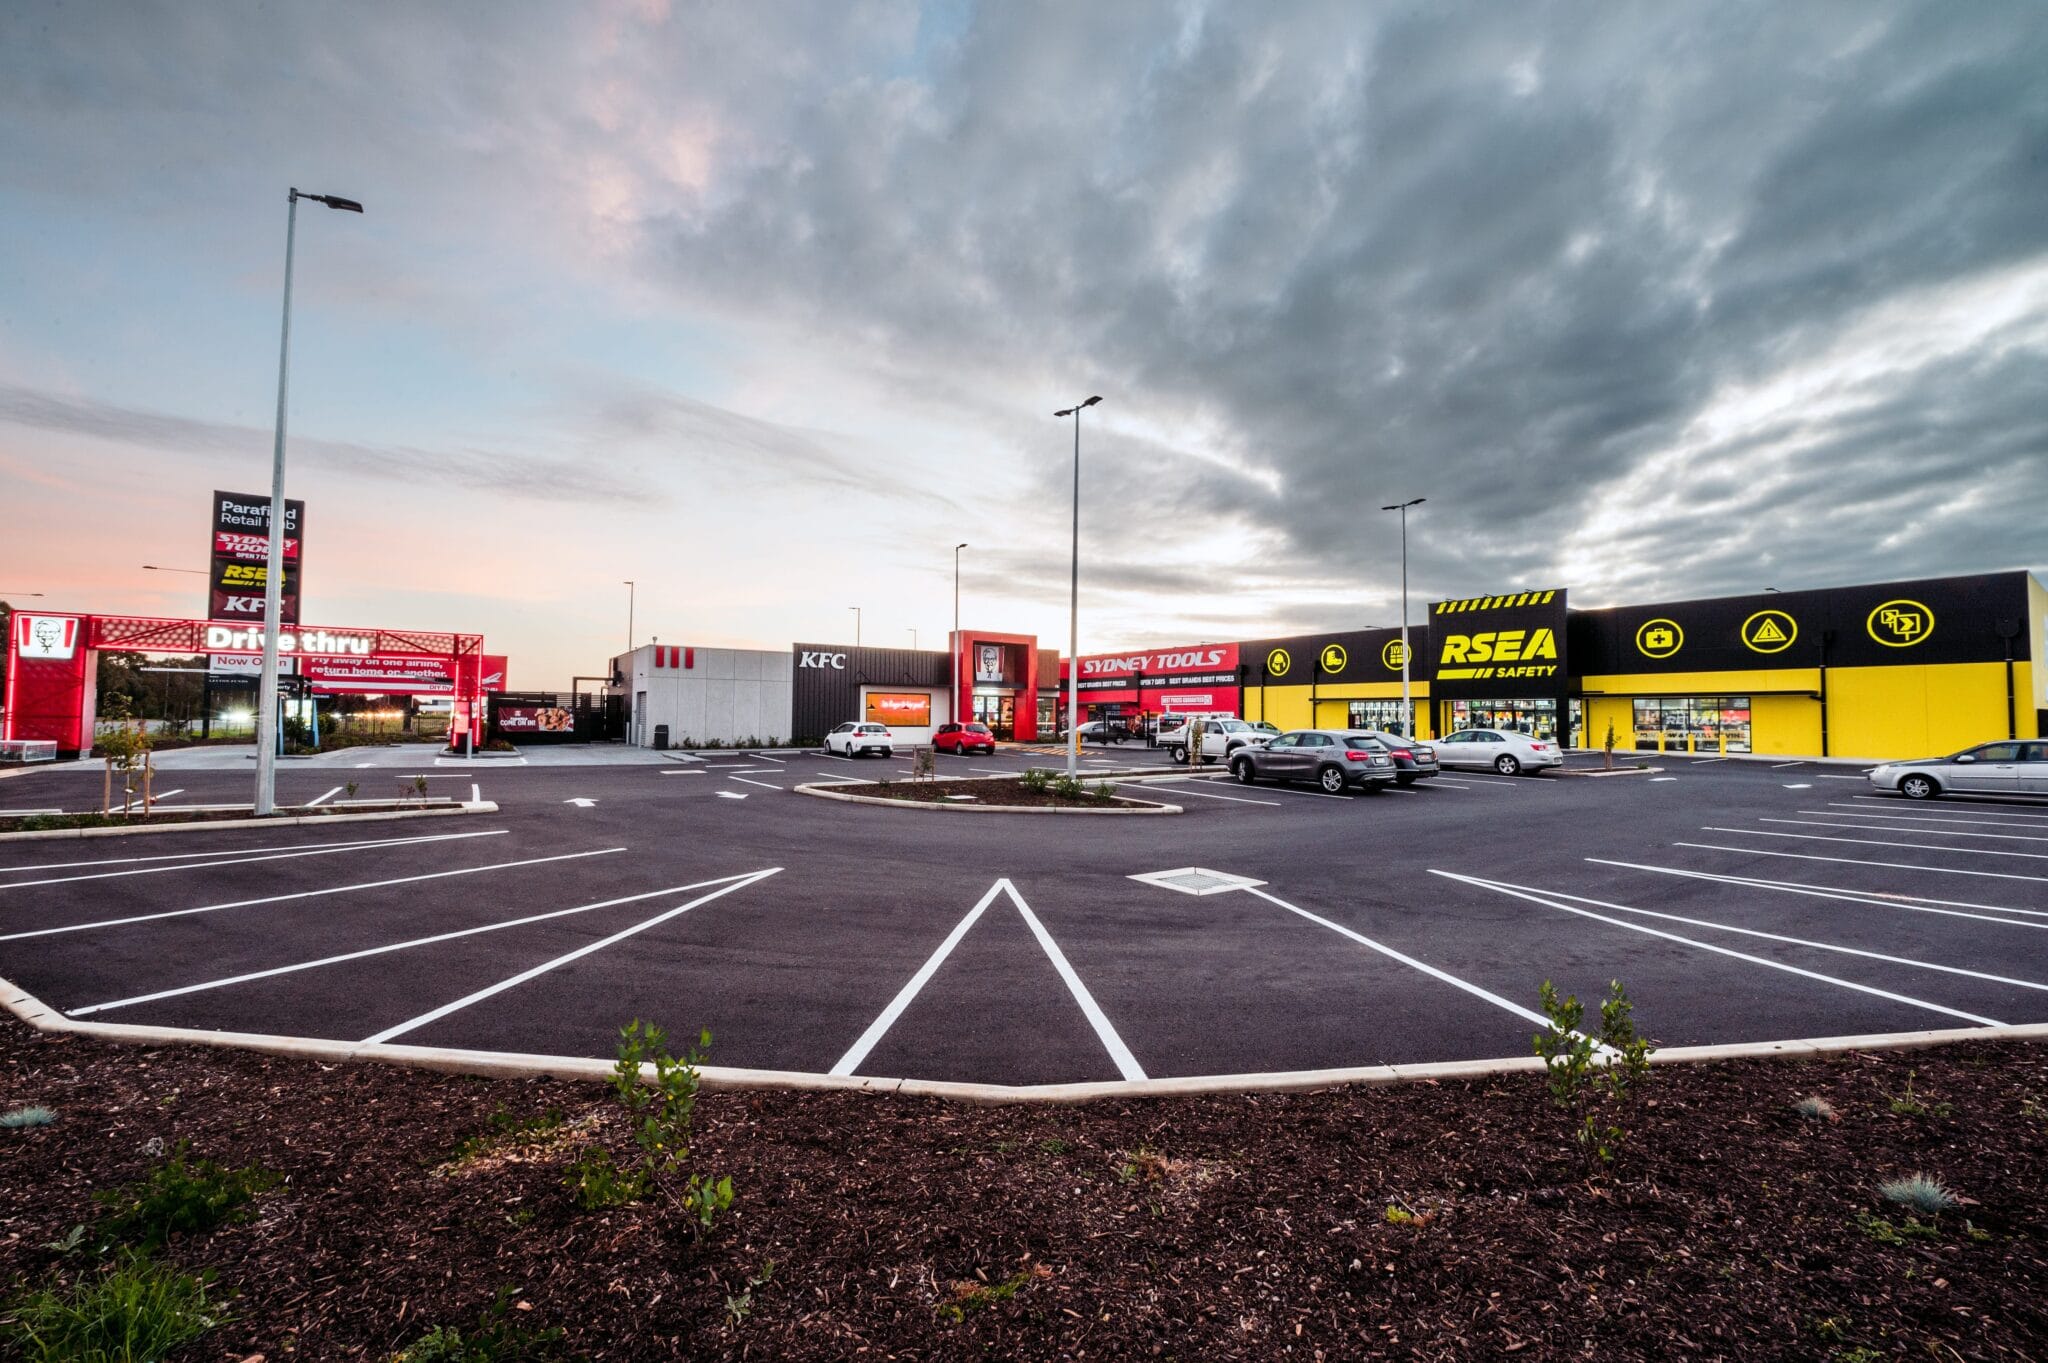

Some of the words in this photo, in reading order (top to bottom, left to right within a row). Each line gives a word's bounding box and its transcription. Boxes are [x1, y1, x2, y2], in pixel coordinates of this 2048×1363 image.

[222, 501, 296, 520] Parafid
[221, 513, 261, 527] Retail
[217, 533, 297, 548] SYDNY
[225, 542, 285, 555] TOOL
[224, 564, 287, 582] RSE
[224, 596, 286, 614] KF
[302, 630, 370, 654] thru
[1440, 628, 1557, 664] RSEA
[217, 656, 248, 666] Now
[252, 657, 287, 667] On
[333, 657, 362, 666] away
[799, 651, 846, 669] KFC
[1083, 655, 1153, 674] SYDNEY
[1157, 650, 1225, 669] TOOLS
[311, 665, 349, 675] return
[352, 667, 384, 676] home
[1496, 665, 1557, 678] SAFETY
[1169, 677, 1181, 685] BEST
[1182, 676, 1201, 684] BRANDS
[1202, 675, 1215, 683] BEST
